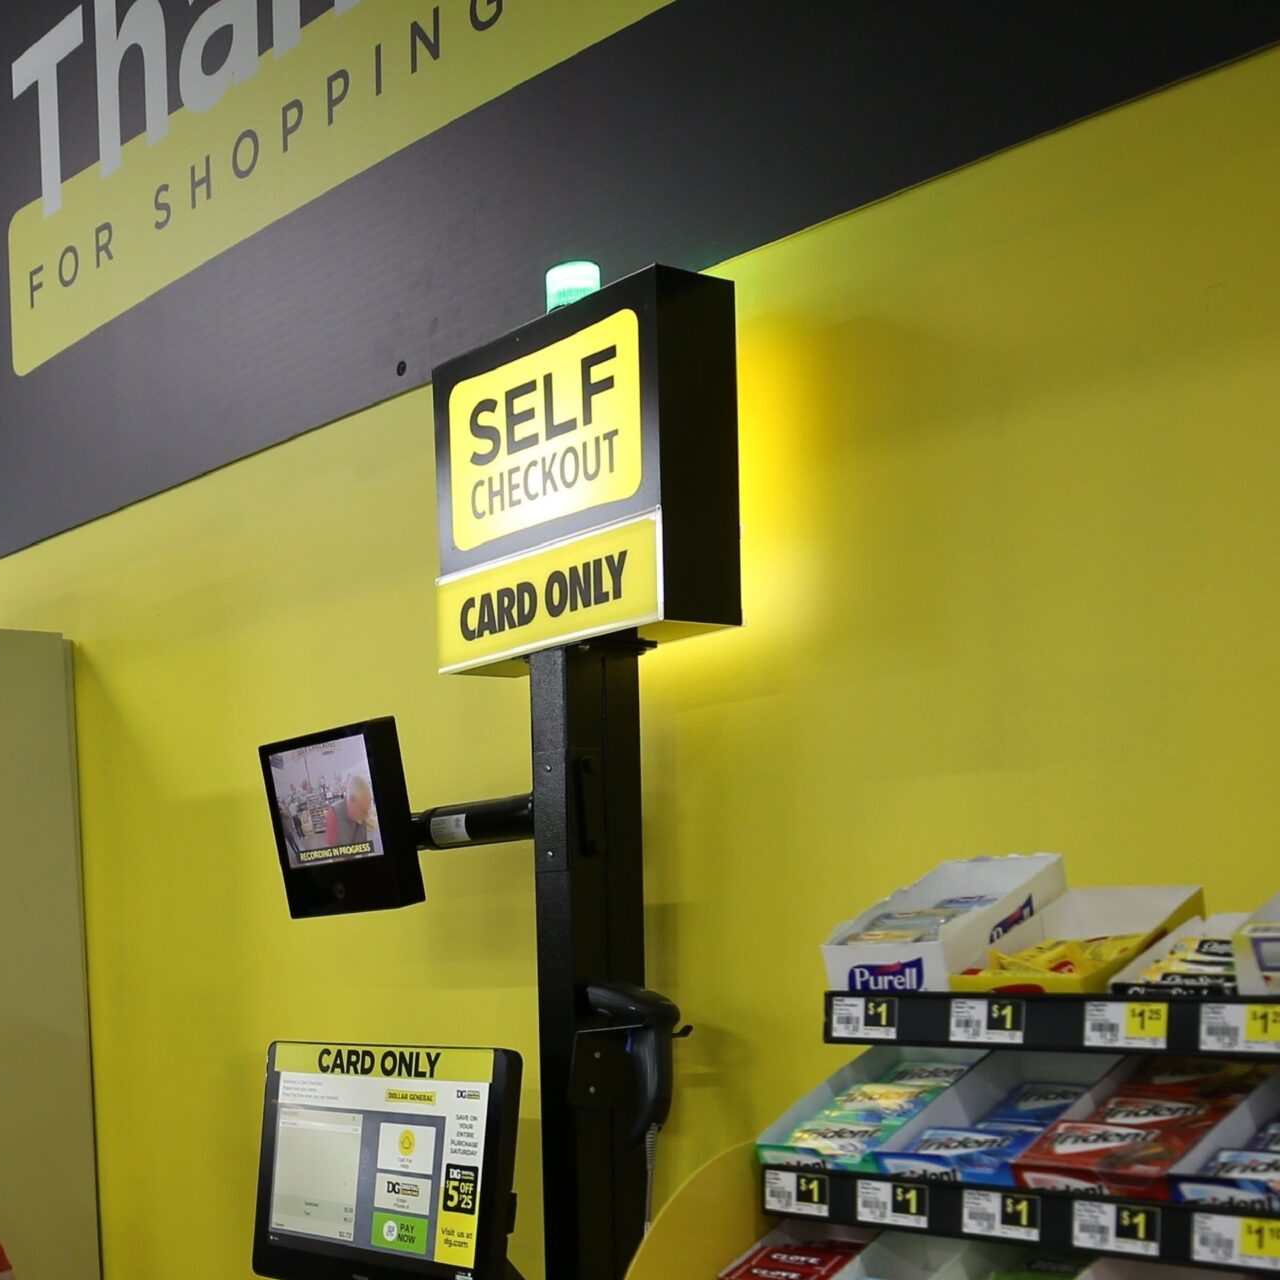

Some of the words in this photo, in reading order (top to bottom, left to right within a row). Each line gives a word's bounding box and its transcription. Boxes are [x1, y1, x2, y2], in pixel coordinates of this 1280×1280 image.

[28, 222, 114, 309] FOR
[469, 344, 618, 467] SELF
[470, 428, 620, 520] CHECKOUT
[460, 570, 538, 642] CARD
[545, 550, 628, 617] ONLY
[300, 847, 333, 861] RECORDING
[333, 847, 340, 856] IN
[339, 843, 371, 855] PROGRESS
[853, 967, 918, 990] Purell
[867, 1002, 888, 1026] $1
[991, 1004, 1014, 1029] $1
[318, 1049, 375, 1075] CARD
[380, 1052, 442, 1079] ONLY
[388, 1092, 408, 1100] DOLLAR
[456, 1089, 467, 1099] DG
[457, 1131, 475, 1139] ENTIRE
[450, 1139, 478, 1148] PURCHASE
[450, 1148, 478, 1157] SATURDAY
[449, 1168, 461, 1180] DG
[387, 1181, 400, 1194] DG
[460, 1182, 474, 1193] OFF
[800, 1178, 819, 1202] $1
[896, 1188, 918, 1214] $1
[1006, 1198, 1029, 1227] $1
[400, 1223, 415, 1234] PAY
[1122, 1211, 1146, 1240] $1
[397, 1233, 416, 1245] NOW
[441, 1227, 455, 1237] Visit
[466, 1231, 473, 1239] at
[443, 1238, 469, 1250] dg.com
[771, 1253, 821, 1265] CLOVE
[751, 1267, 802, 1280] CLOVE
